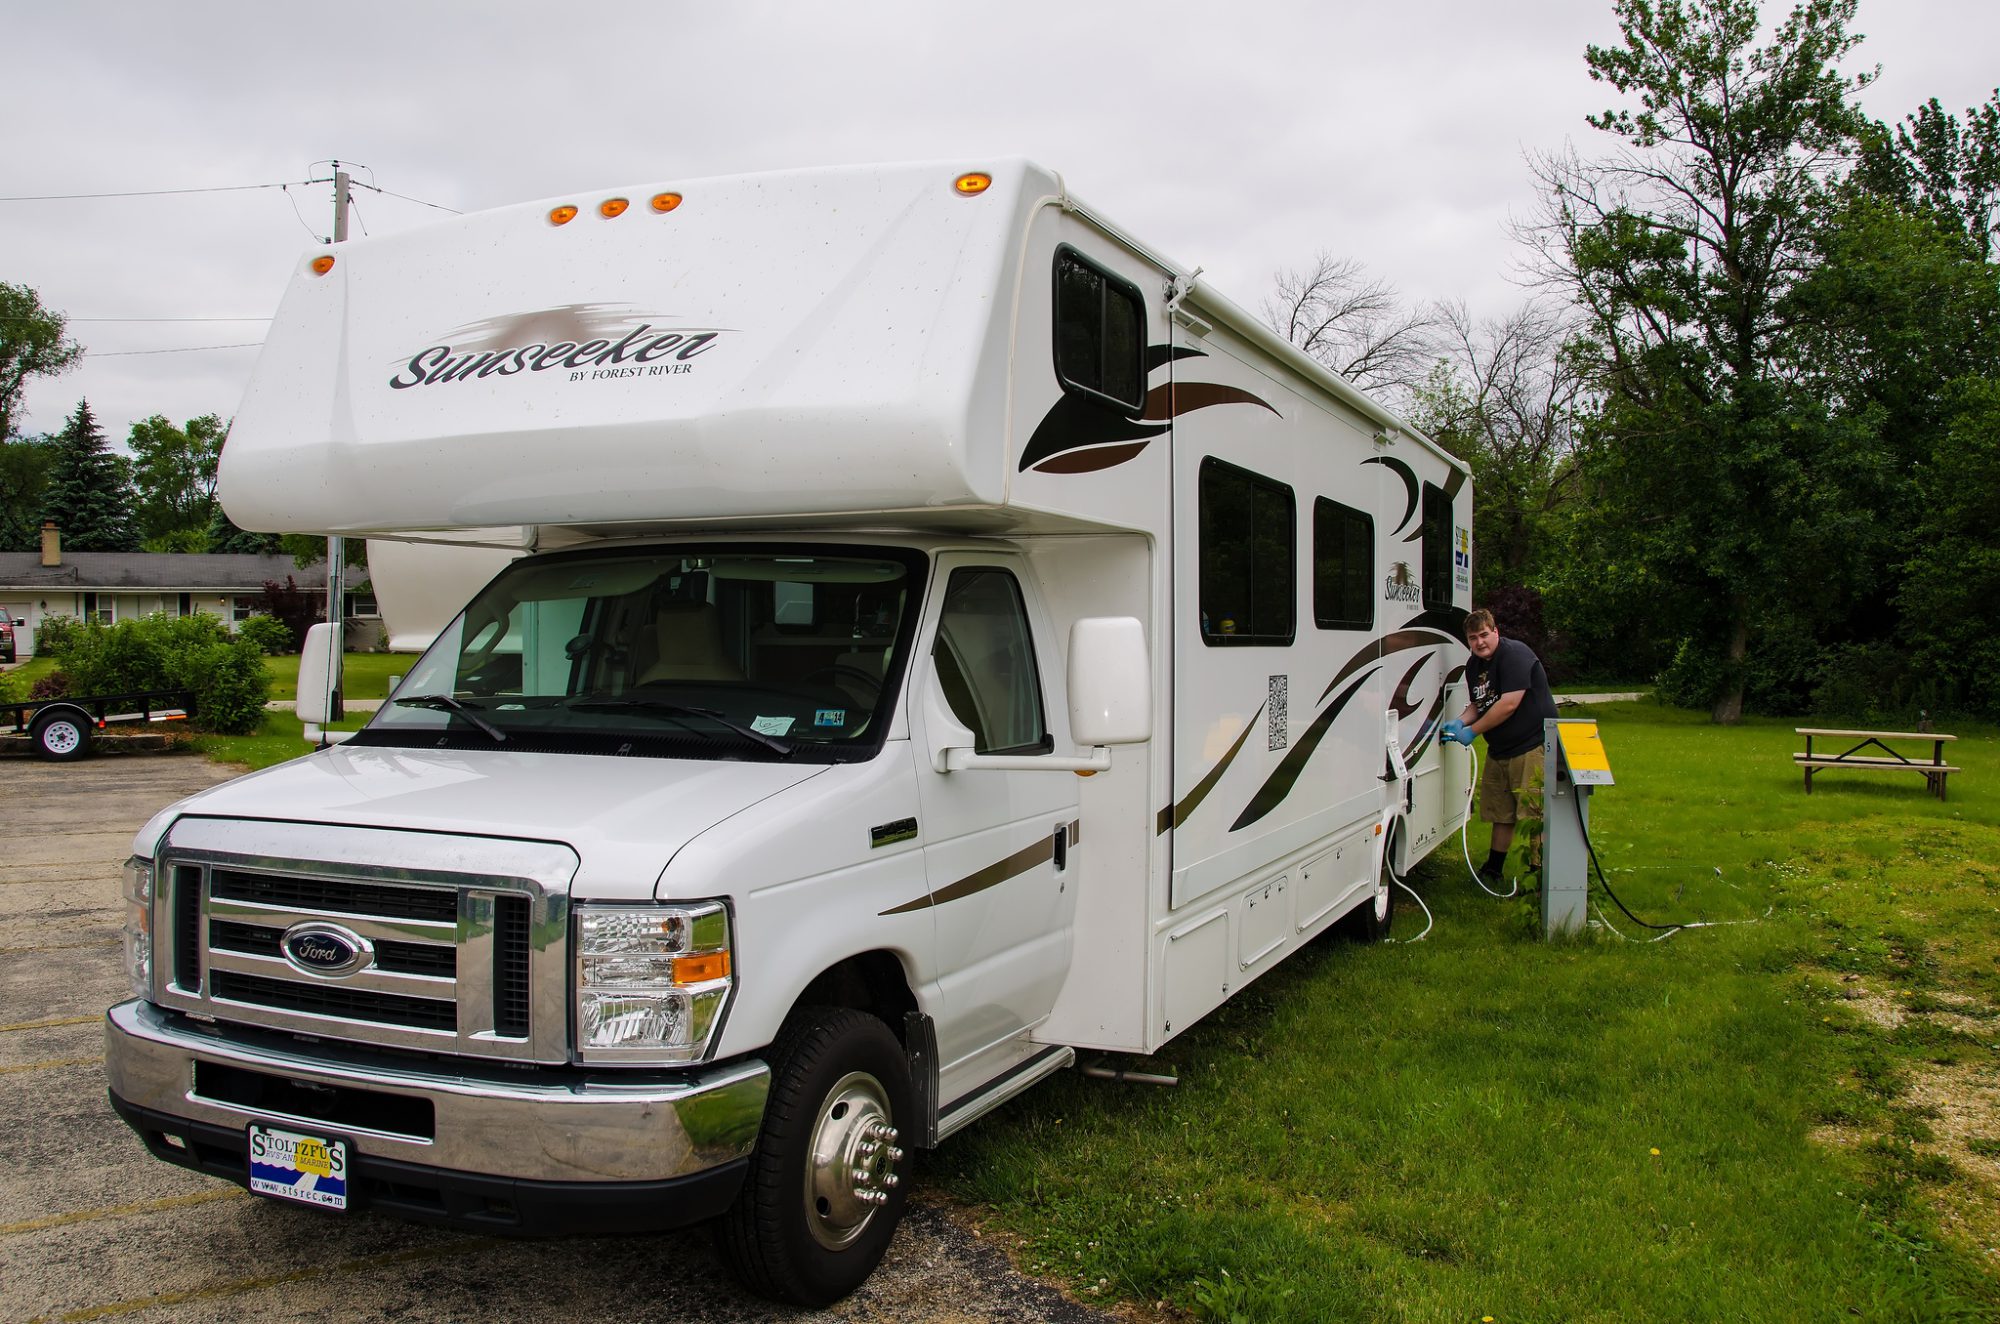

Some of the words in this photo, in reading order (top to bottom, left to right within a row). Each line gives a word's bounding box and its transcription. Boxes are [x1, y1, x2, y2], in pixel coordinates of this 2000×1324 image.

[389, 323, 719, 390] Sunseeker
[569, 370, 586, 382] BY
[592, 366, 646, 380] FOREST
[648, 363, 692, 377] RIVER
[299, 936, 337, 960] Ford
[252, 1134, 343, 1171] STOLTZFUS
[282, 1153, 298, 1163] AND
[299, 1157, 329, 1169] MARINE
